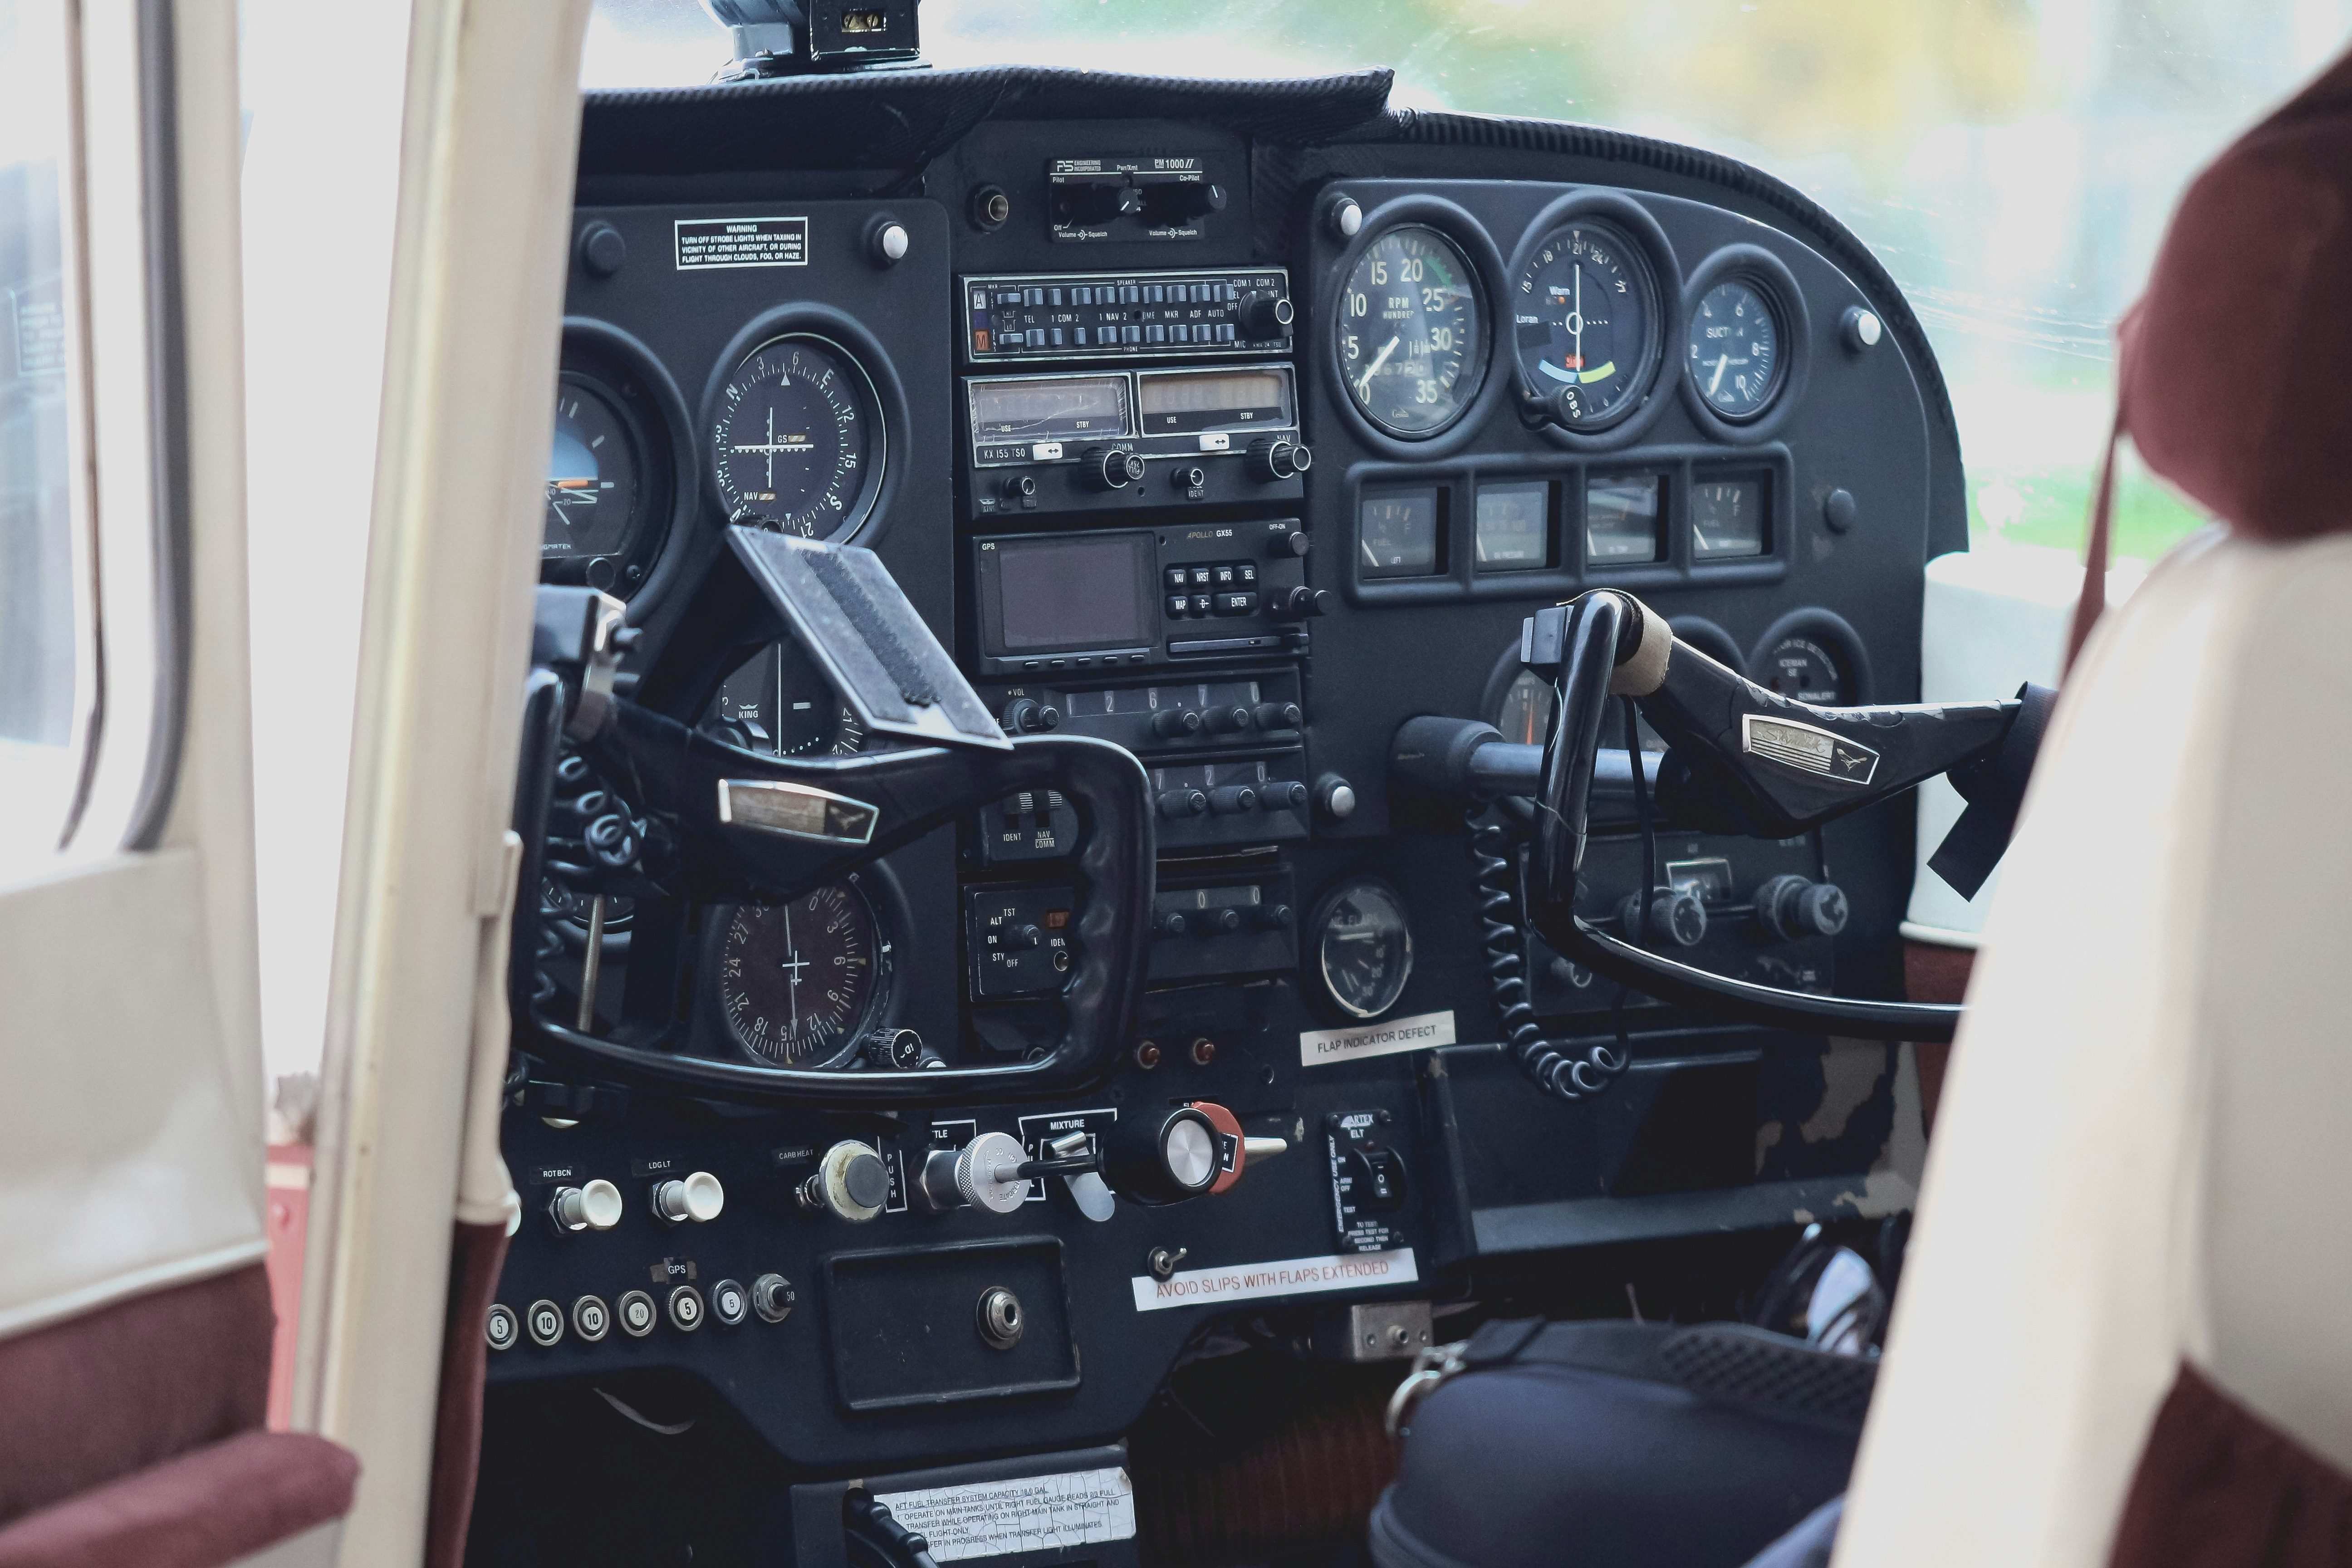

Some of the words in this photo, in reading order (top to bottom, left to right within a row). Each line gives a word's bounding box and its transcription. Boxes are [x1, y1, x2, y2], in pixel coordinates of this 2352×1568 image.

[726, 225, 757, 233] WARNING
[710, 235, 733, 243] STROBE
[1371, 261, 1388, 285] 15
[1401, 259, 1423, 282] 20
[1350, 293, 1367, 318] 10
[1388, 297, 1409, 310] RPM
[1423, 288, 1445, 312] 25
[1227, 303, 1237, 311] OFF
[1234, 340, 1245, 348] MIC
[1431, 327, 1451, 351] 30
[1348, 335, 1359, 359] 5
[757, 357, 764, 370] 3
[793, 352, 799, 365] 6
[1416, 379, 1438, 403] 35
[1566, 391, 1581, 418] OBS
[841, 405, 854, 423] 12
[1001, 424, 1011, 433] USE
[1076, 420, 1089, 429] STBY
[1112, 443, 1133, 451] COMM
[984, 450, 994, 459] KX
[996, 449, 1008, 458] 155
[1011, 449, 1025, 458] TSO
[845, 452, 856, 469] 15
[744, 491, 758, 500] NAV
[1174, 574, 1184, 583] NAV
[1197, 572, 1209, 581] NRST
[1220, 572, 1231, 580] INFO
[1245, 571, 1254, 579] SEL
[1176, 600, 1186, 609] MAP
[1231, 597, 1247, 607] ENTER
[1003, 833, 1021, 842] IDENT
[1038, 830, 1050, 838] NAV
[1035, 840, 1054, 848] COMM
[809, 897, 818, 911] 0
[1004, 908, 1015, 916] TST
[828, 921, 839, 933] 3
[990, 917, 1002, 925] ALT
[735, 923, 749, 944] 27
[988, 936, 997, 944] ON
[834, 956, 845, 965] 6
[993, 953, 1004, 961] STY
[729, 957, 741, 977] 24
[735, 992, 750, 1010] 21
[755, 1017, 768, 1035] 18
[807, 1013, 822, 1030] 12
[1318, 1040, 1341, 1053] FLAP
[1344, 1031, 1395, 1049] INDICATOR
[1399, 1025, 1436, 1039] DEFECT
[1051, 1119, 1085, 1130] MIXTURE
[1351, 1129, 1364, 1138] ELT
[887, 1153, 896, 1198] PUSH
[668, 1266, 686, 1274] GPS
[1156, 1281, 1198, 1298] AVOID
[1203, 1276, 1240, 1293] SLIPS
[1244, 1272, 1276, 1288] WITH
[1280, 1268, 1319, 1284] FLAPS
[1323, 1261, 1388, 1280] EXTENDED
[787, 1292, 794, 1301] 50
[685, 1303, 691, 1314] 5
[730, 1299, 734, 1308] 5
[587, 1313, 598, 1325] 10
[635, 1309, 644, 1318] 20
[497, 1320, 503, 1334] 5
[541, 1317, 553, 1329] 10
[926, 1496, 960, 1506] TRANSFER
[962, 1493, 987, 1502] SYSTEM
[989, 1489, 1019, 1499] CAPACITY
[905, 1511, 933, 1519] OPERATE
[965, 1504, 984, 1513] TANKS
[1005, 1500, 1024, 1509] RIGHT
[1044, 1494, 1066, 1503] GAUGE
[1067, 1492, 1088, 1500] READS
[907, 1520, 940, 1530] TRANSFER
[963, 1513, 998, 1523] OPERATING
[1075, 1501, 1104, 1510] STRAIGHT
[929, 1529, 951, 1538] FLIGHT
[953, 1527, 969, 1535] ONLY
[952, 1535, 987, 1544] PROGRESS
[989, 1533, 1007, 1541] WHEN
[1010, 1527, 1041, 1538] TRANSFER
[1063, 1521, 1102, 1532] ILLUMINATES
